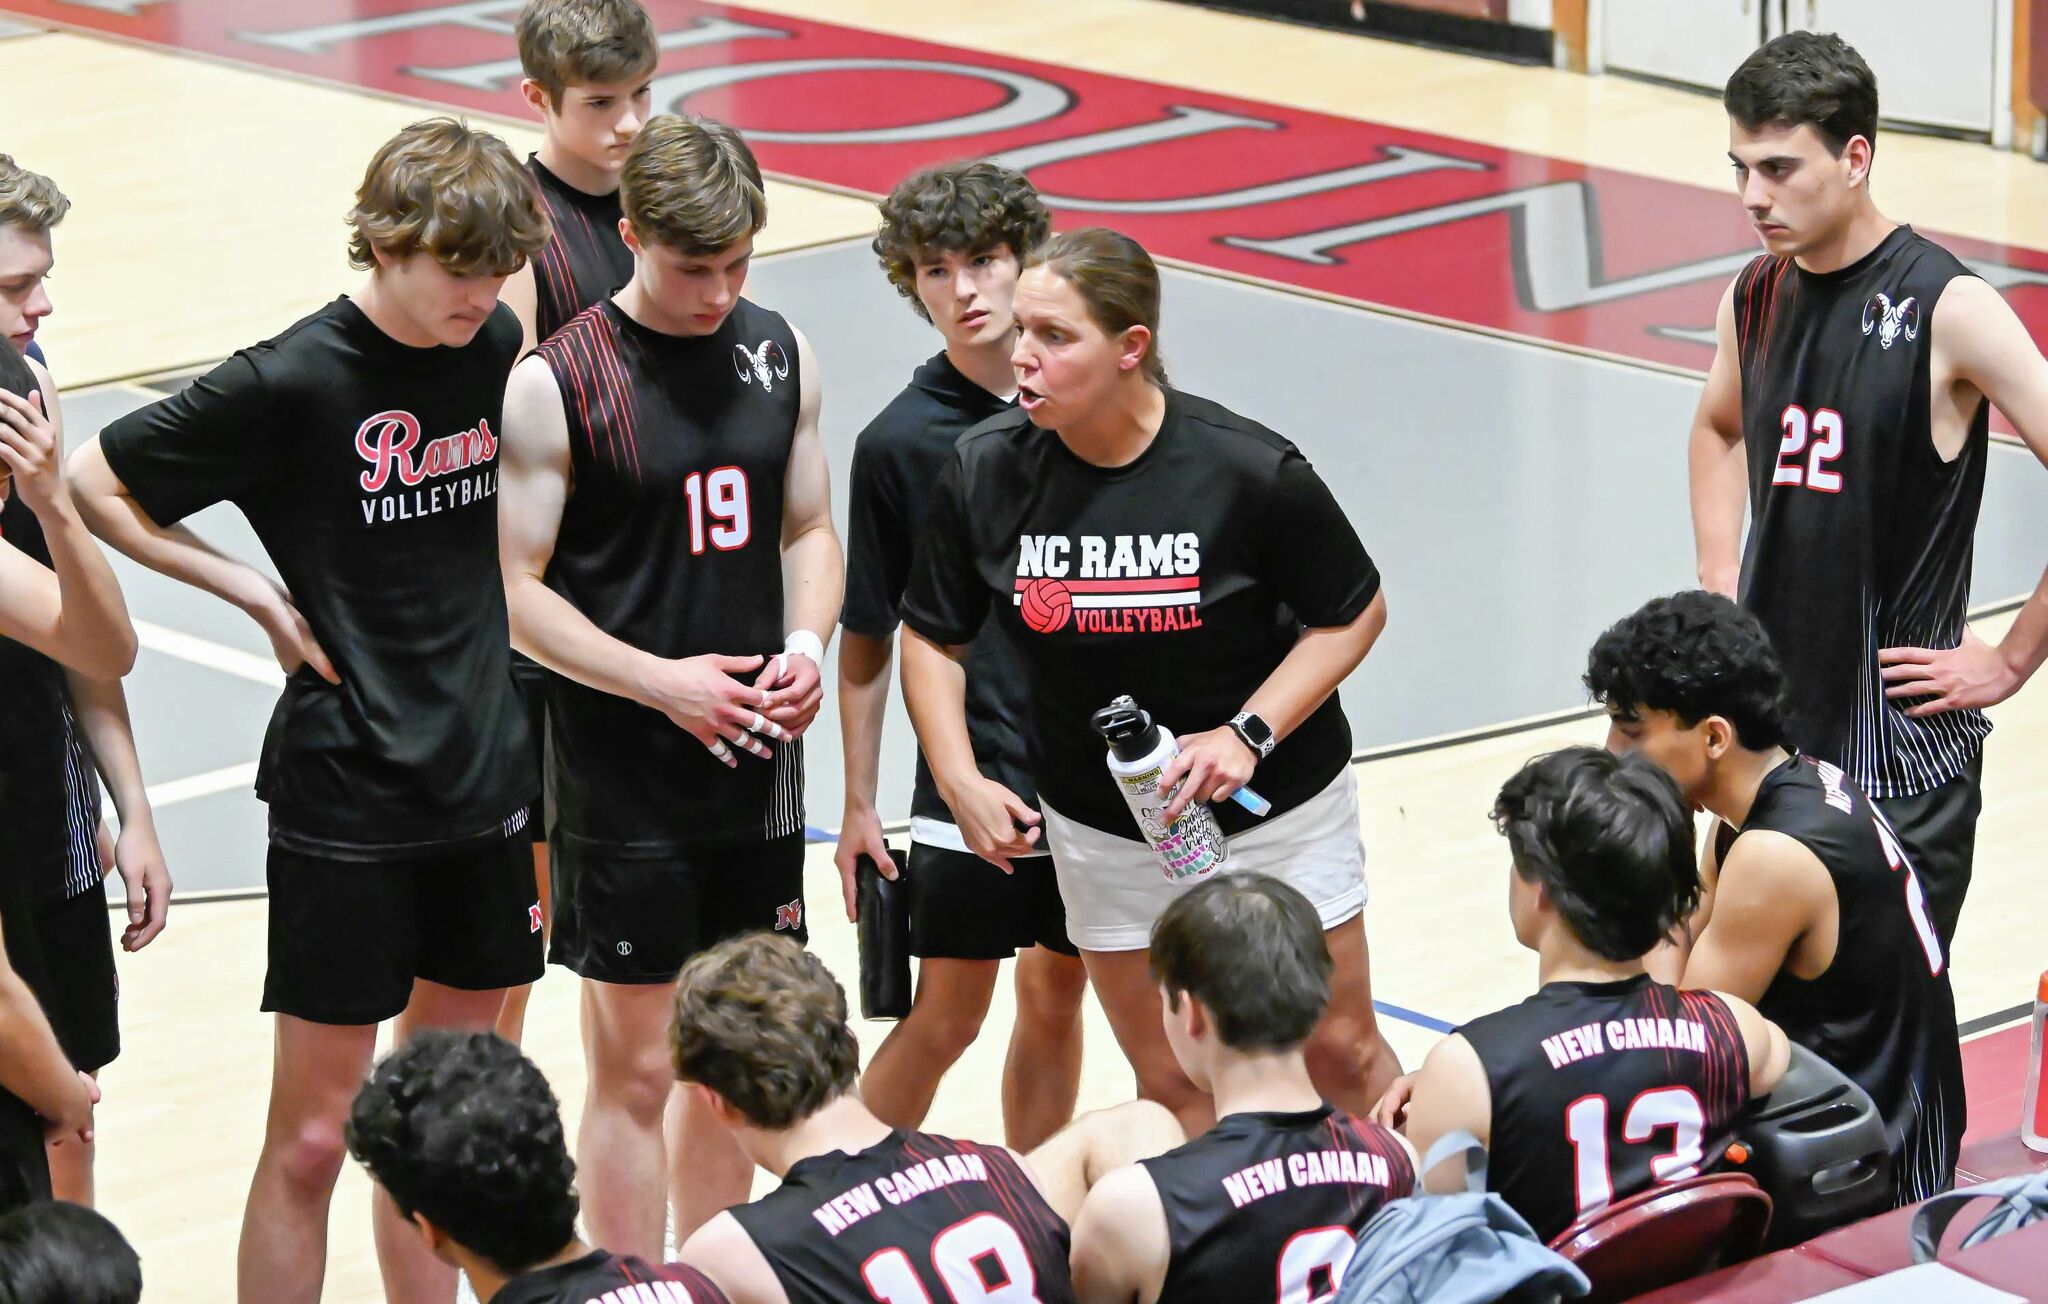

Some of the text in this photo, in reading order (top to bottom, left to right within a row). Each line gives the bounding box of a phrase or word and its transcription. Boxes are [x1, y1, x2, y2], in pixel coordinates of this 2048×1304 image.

[355, 410, 498, 492] Rams
[1771, 404, 1844, 494] 22
[361, 469, 499, 524] VOLLEYBALL
[684, 465, 752, 555] 19
[1016, 532, 1200, 578] NC RAMS
[1074, 605, 1202, 633] VOLLEYBALL
[1128, 768, 1159, 782] WARNING
[1540, 1017, 1706, 1070] NEW CANAAN
[1221, 1150, 1390, 1210] NEW CANAAN
[1564, 1084, 1707, 1223] 13
[811, 1152, 989, 1237] NEW CANAAN
